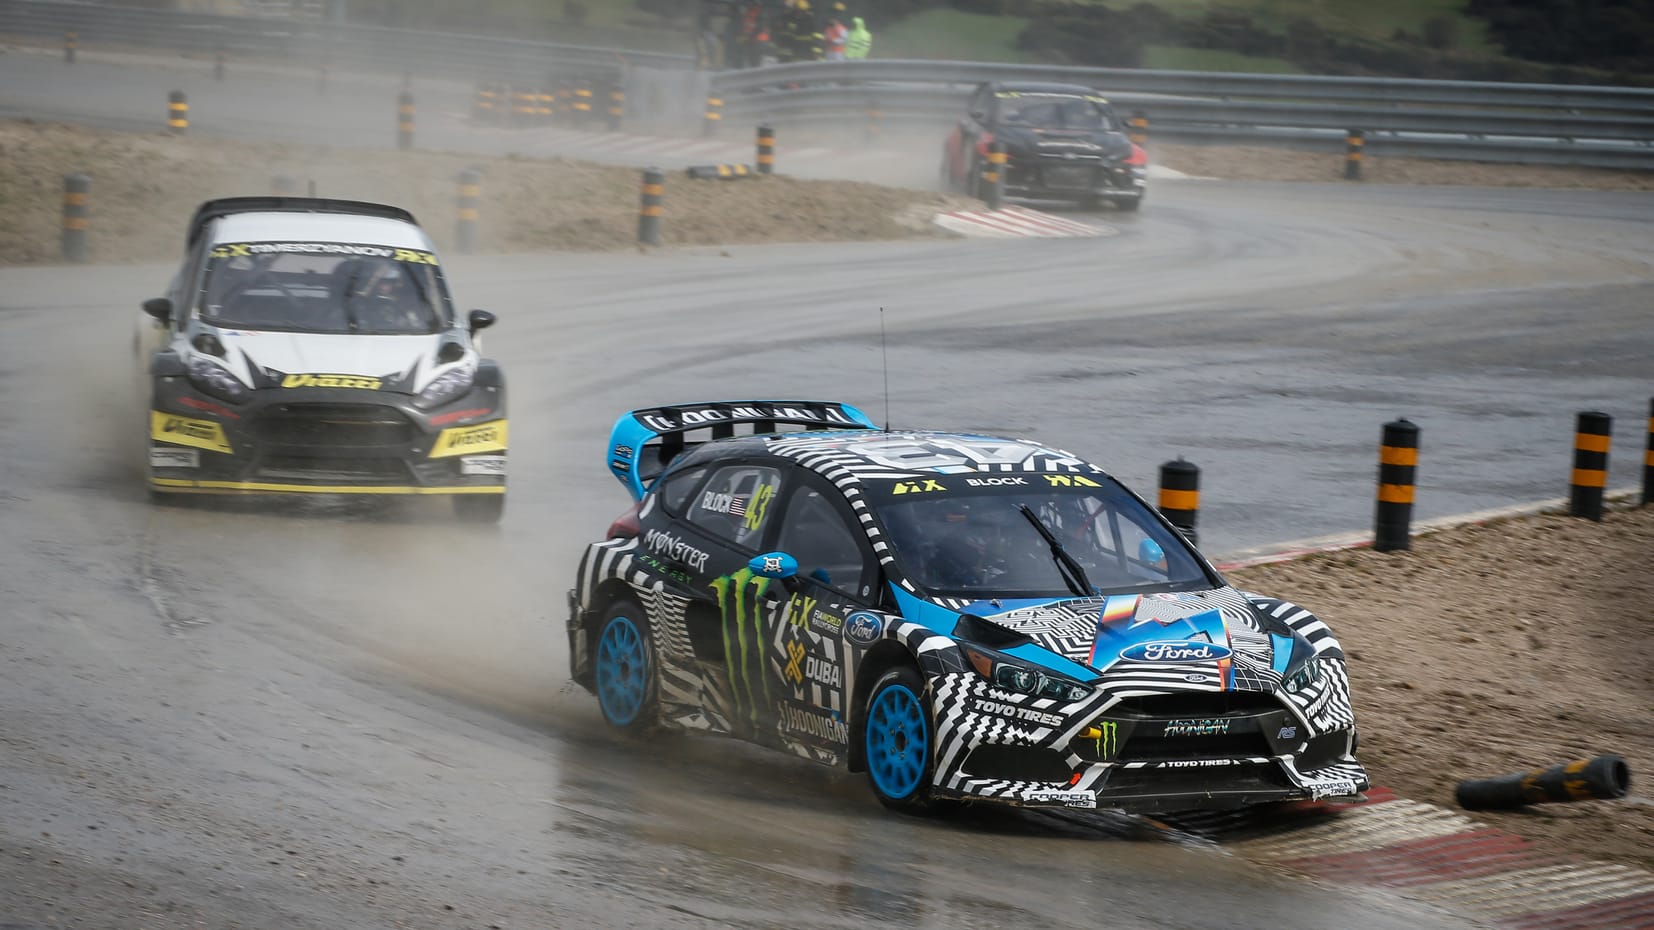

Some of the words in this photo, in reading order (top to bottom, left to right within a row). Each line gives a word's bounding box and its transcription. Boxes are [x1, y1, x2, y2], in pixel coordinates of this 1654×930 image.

[966, 476, 1028, 488] BLOCK
[701, 491, 733, 514] BLOCK
[744, 483, 773, 531] 43
[850, 615, 876, 640] Ford
[1144, 642, 1213, 661] Ford
[974, 699, 1016, 717] TOYO
[1016, 707, 1065, 727] TIRES
[1163, 719, 1230, 738] HOONIGAN
[1276, 726, 1295, 739] RS
